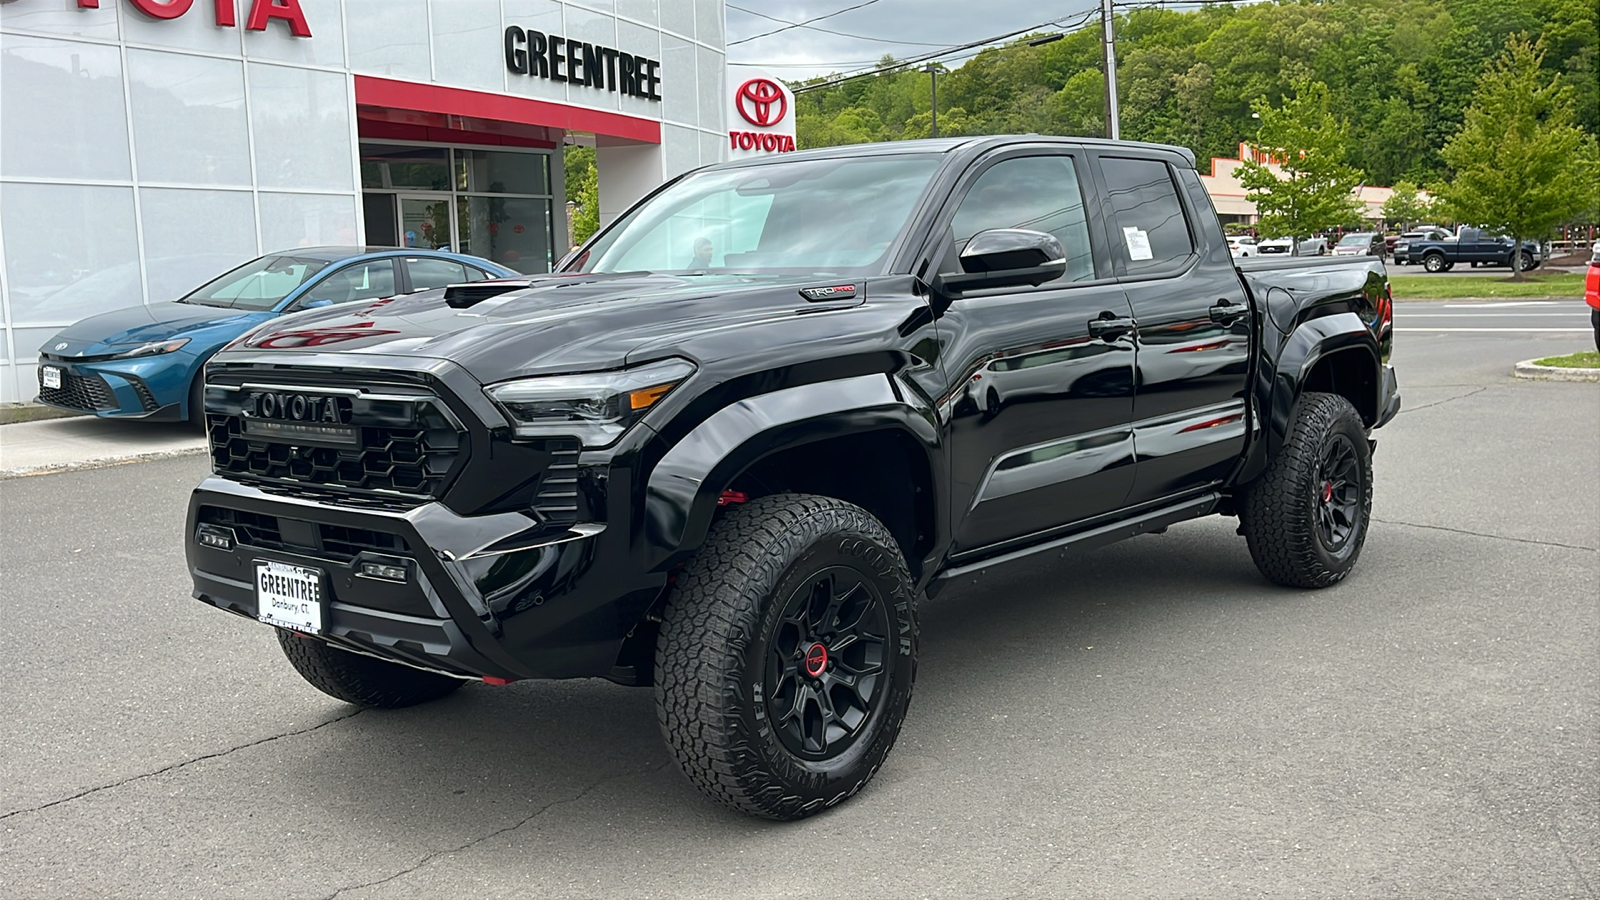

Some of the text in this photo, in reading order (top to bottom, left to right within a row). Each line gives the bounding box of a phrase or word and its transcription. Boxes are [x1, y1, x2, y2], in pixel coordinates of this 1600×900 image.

[504, 25, 661, 101] GREENTREE
[729, 131, 796, 153] TOYOTA
[250, 392, 338, 422] TOYOTA
[261, 572, 320, 603] GREENTREE
